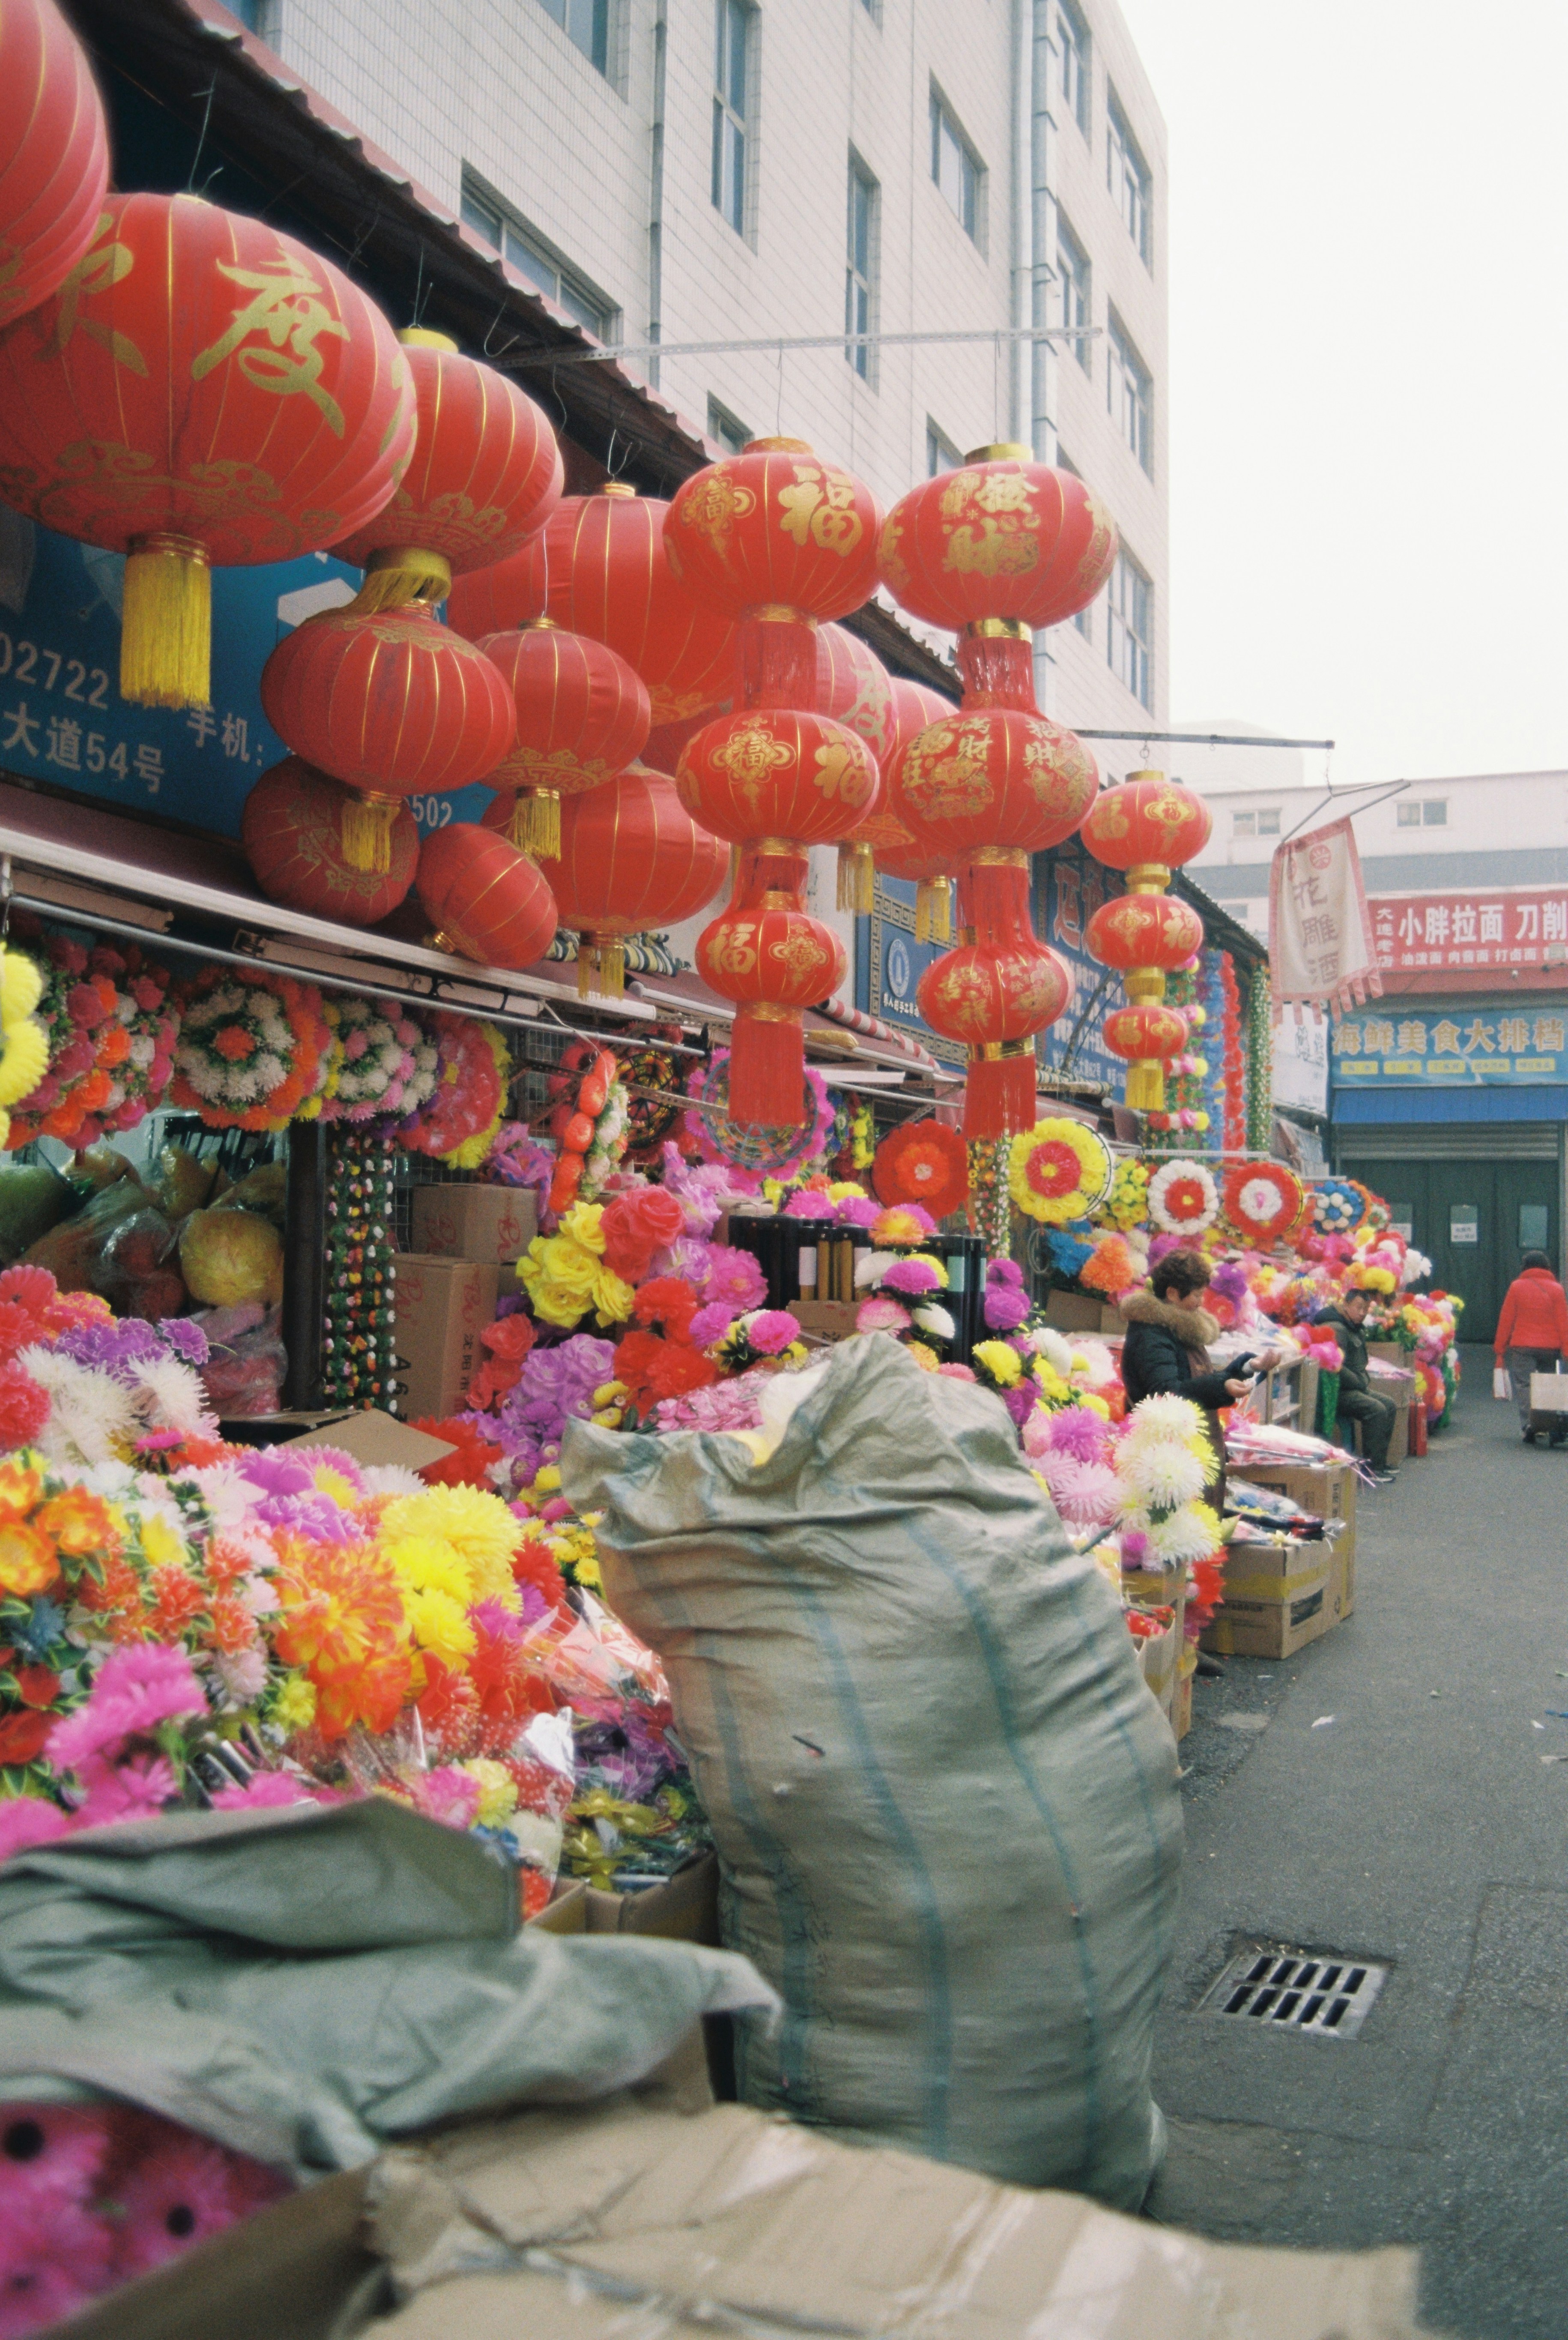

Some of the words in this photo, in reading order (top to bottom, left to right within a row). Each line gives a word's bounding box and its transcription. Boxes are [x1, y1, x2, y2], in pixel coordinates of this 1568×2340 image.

[777, 465, 864, 558] 福
[3, 702, 165, 794] 大道54号
[730, 737, 768, 770] 福
[1163, 906, 1200, 950] 福
[1292, 876, 1339, 985] 花雕酒
[1398, 904, 1504, 946] 小胖拉面
[1515, 900, 1567, 940] 刀削
[706, 923, 757, 975] 福
[1331, 1017, 1565, 1056] 海鲜美食大排档
